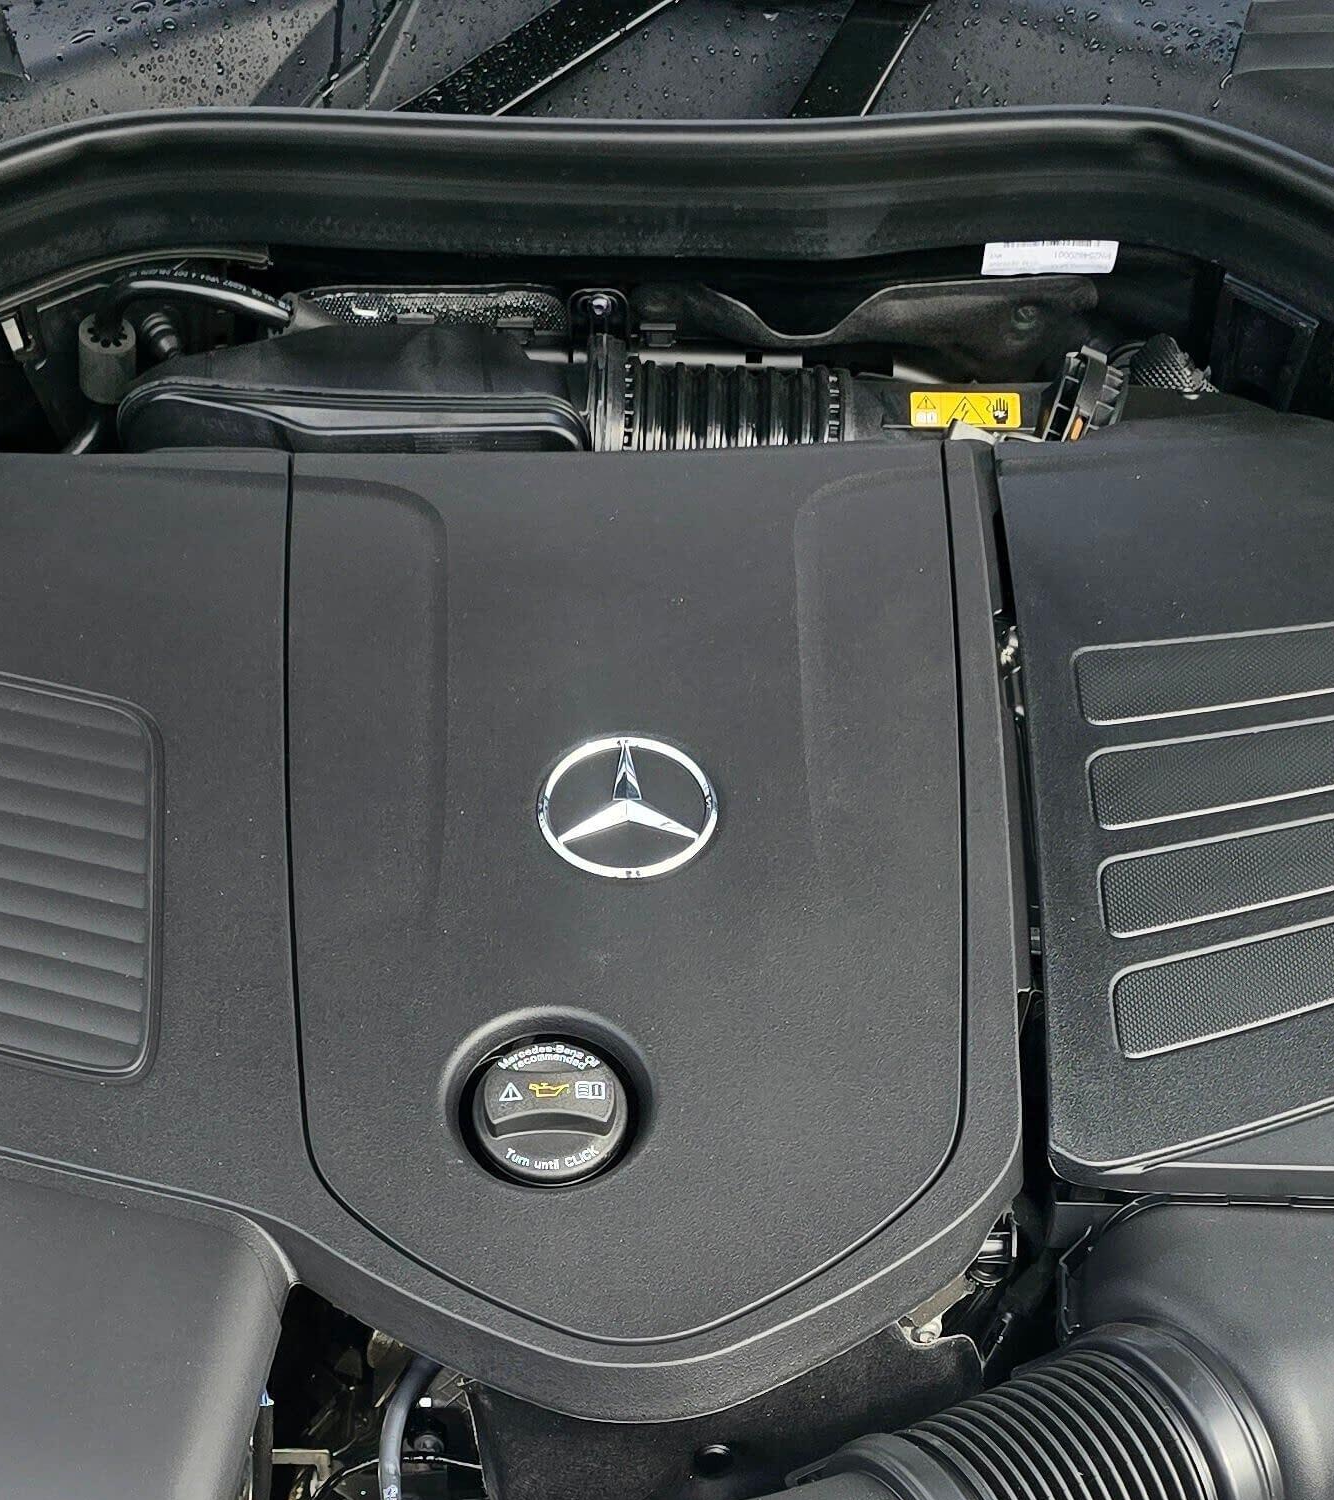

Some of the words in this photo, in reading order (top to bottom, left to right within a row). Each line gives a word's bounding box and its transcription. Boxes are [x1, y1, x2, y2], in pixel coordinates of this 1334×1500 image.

[497, 1045, 584, 1069] Mercedes-Benz
[513, 1054, 588, 1071] recommended
[505, 1147, 530, 1167] Turn
[534, 1157, 560, 1170] until
[564, 1145, 599, 1168] CLICK
